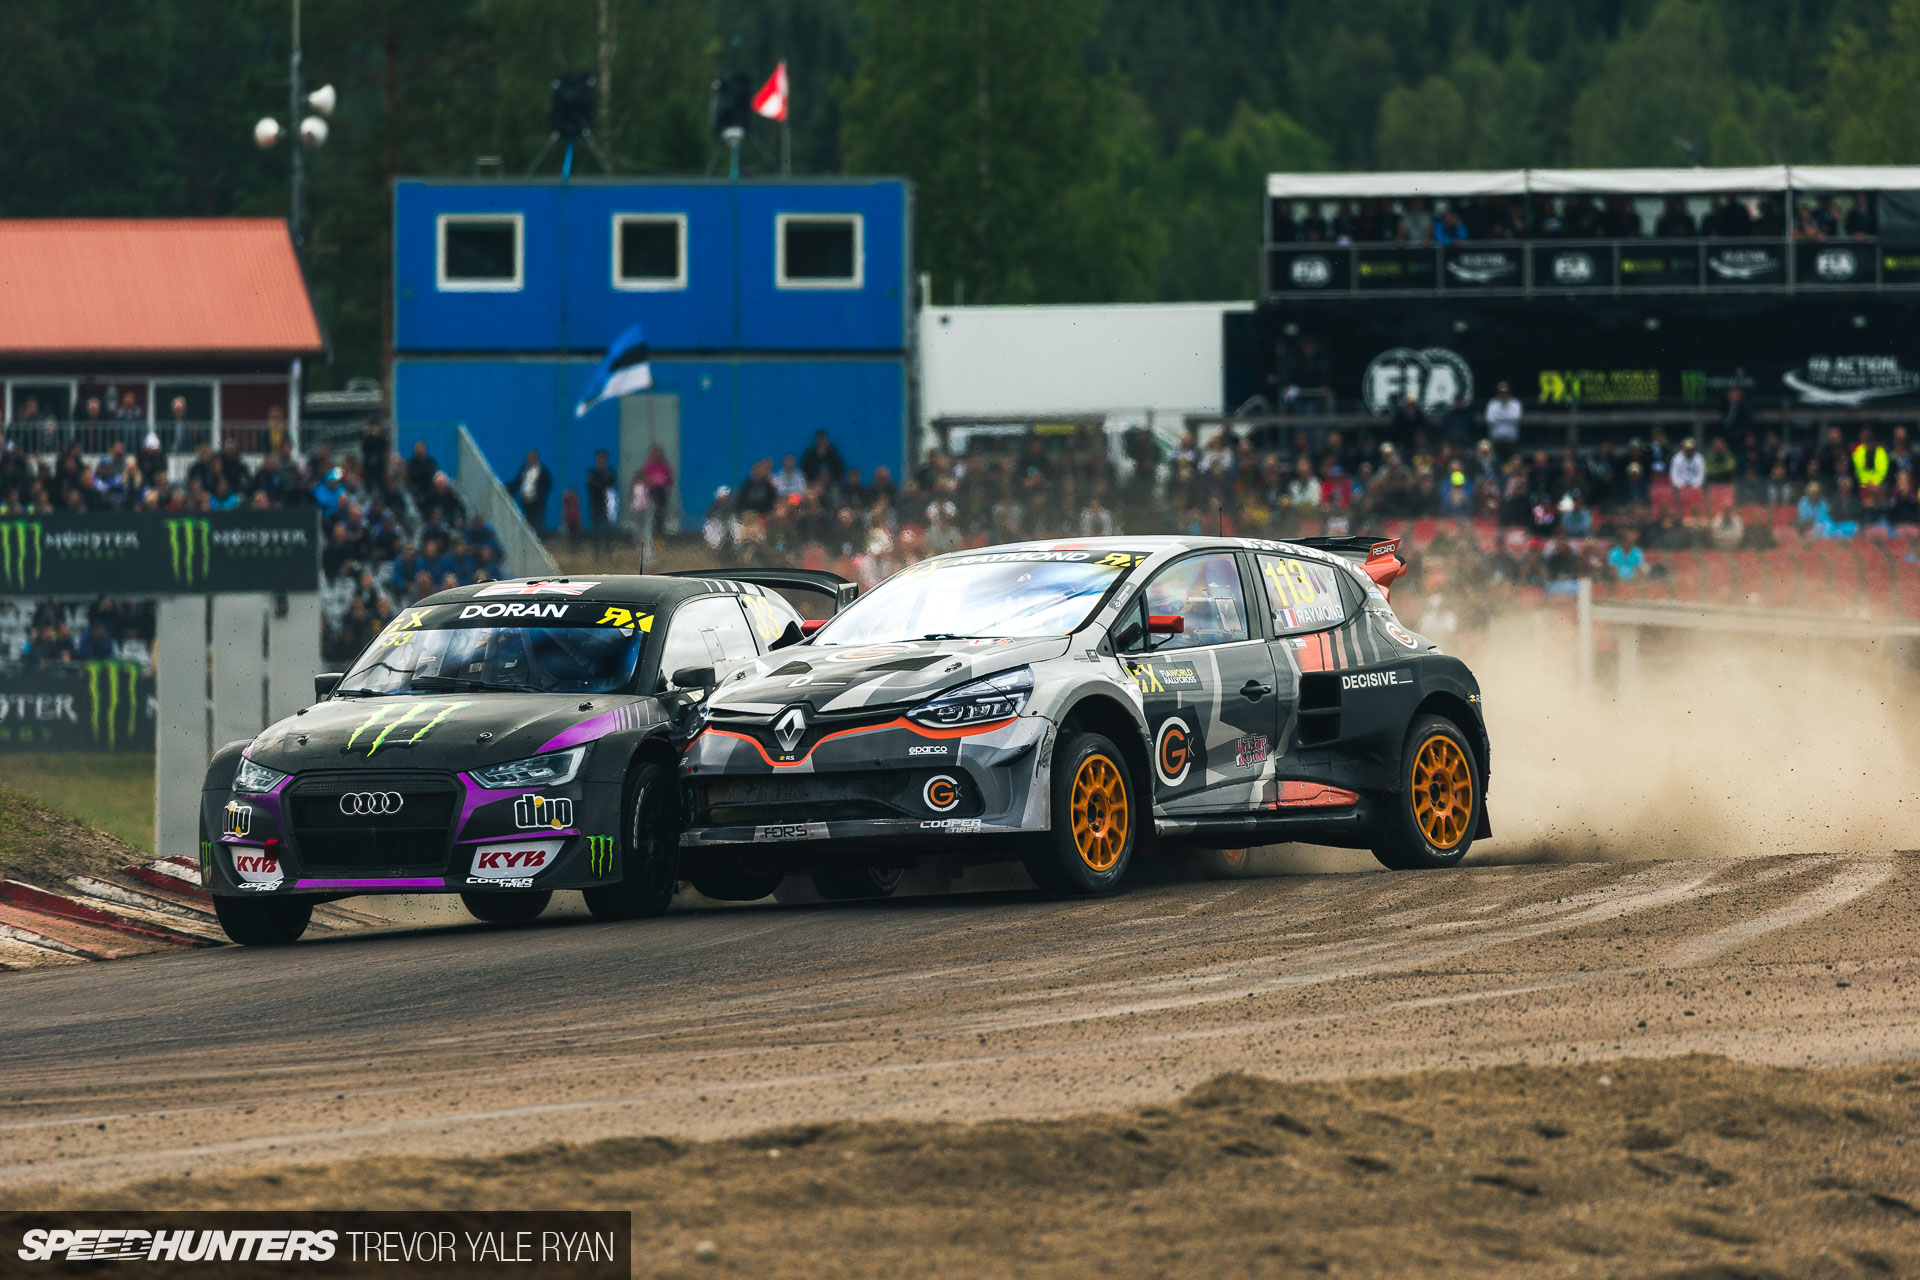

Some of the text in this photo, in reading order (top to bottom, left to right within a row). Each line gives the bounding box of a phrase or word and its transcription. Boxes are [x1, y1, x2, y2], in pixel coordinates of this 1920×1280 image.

[1372, 543, 1396, 557] RECARO
[954, 551, 1091, 567] RAYMOND
[1264, 558, 1316, 608] 113
[459, 603, 569, 620] DORAN
[742, 595, 783, 640] 33
[1297, 604, 1345, 625] RAYMOND
[381, 631, 415, 647] 33
[919, 818, 983, 829] COOPER
[477, 850, 547, 869] KYB
[465, 876, 535, 885] COOPER
